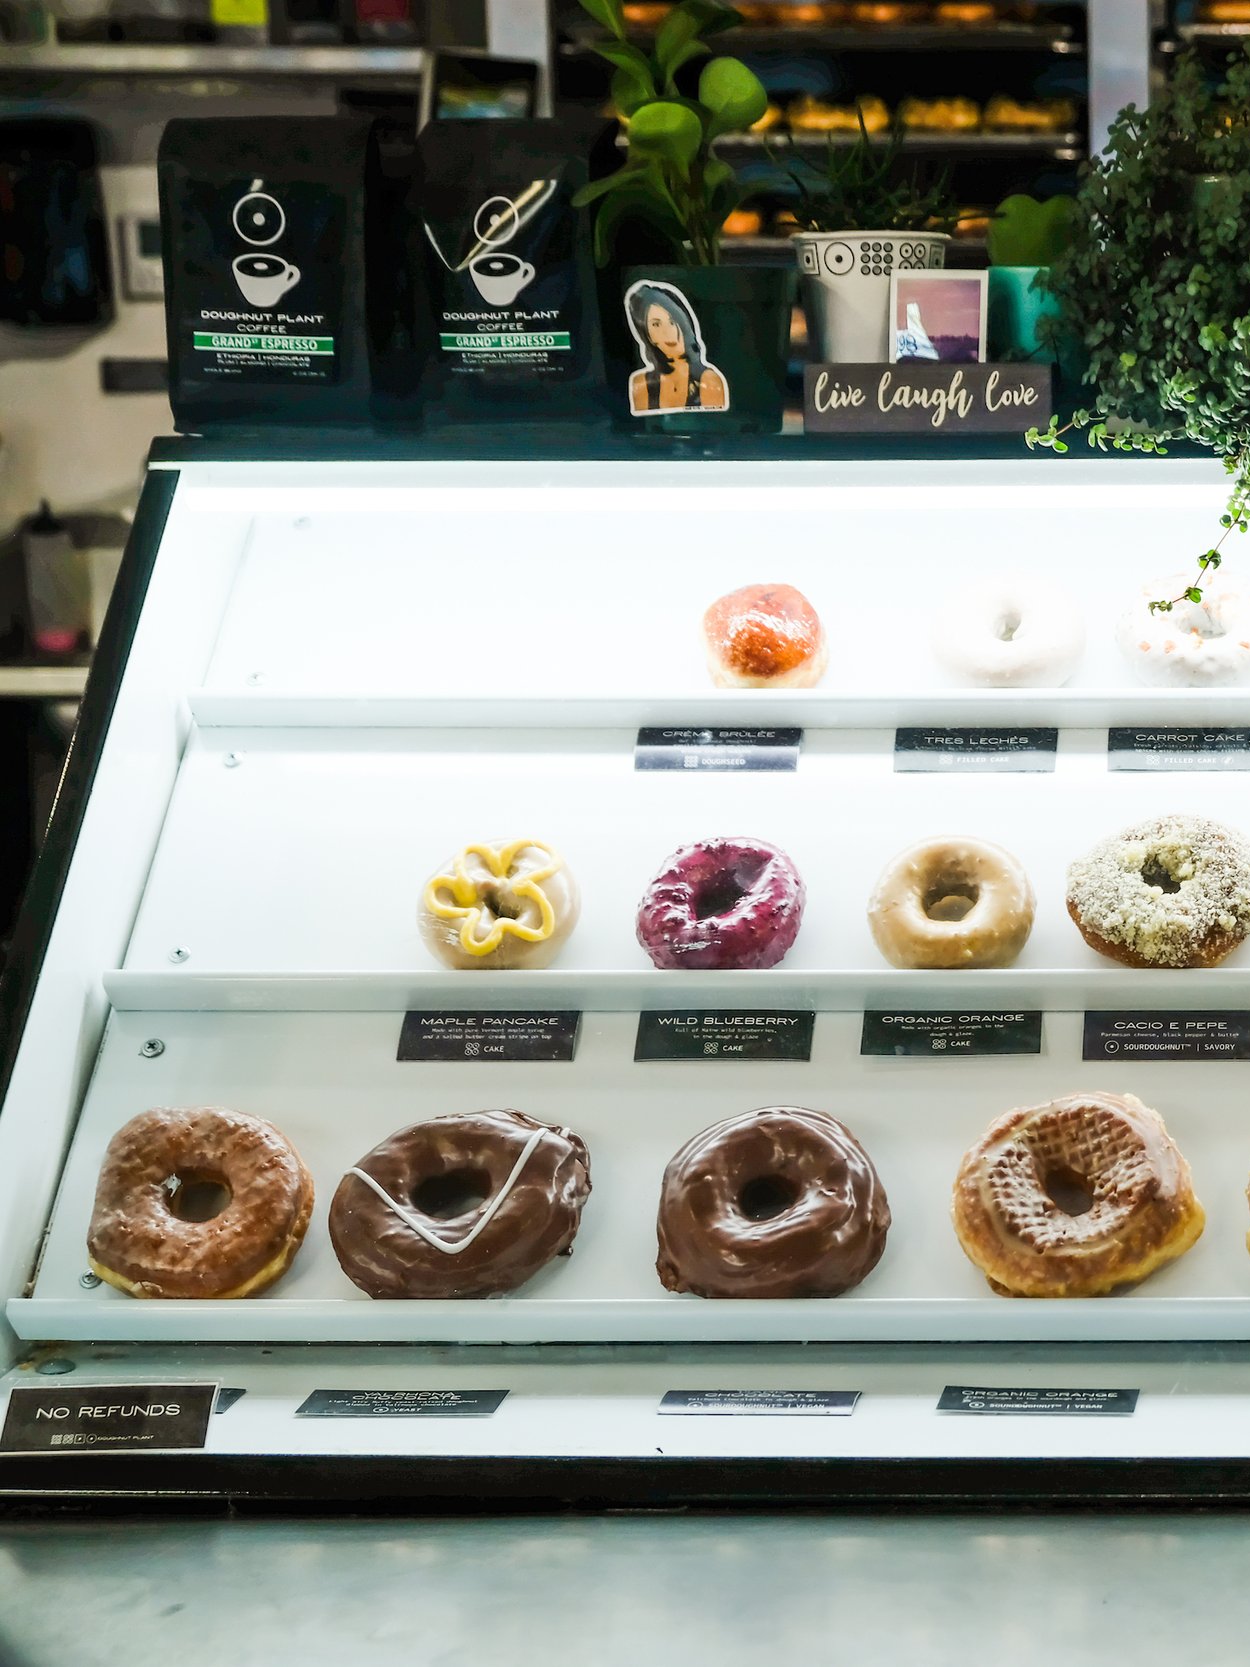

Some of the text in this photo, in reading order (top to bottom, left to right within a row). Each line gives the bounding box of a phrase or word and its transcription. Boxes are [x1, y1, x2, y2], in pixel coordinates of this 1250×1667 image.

[201, 310, 324, 323] DOUGHNUT PLANT
[443, 311, 559, 320] DOUGHNUT PLANT
[237, 324, 287, 334] COFFEE
[477, 323, 524, 331] COFFEE
[261, 339, 318, 350] ESPRESSO
[501, 336, 554, 346] ESPRESSO
[815, 370, 1038, 427] live laugh love
[703, 1017, 798, 1025] BLUEBERRY
[958, 1014, 1025, 1022] ORANGE
[36, 1404, 180, 1420] NO REFUNDS
